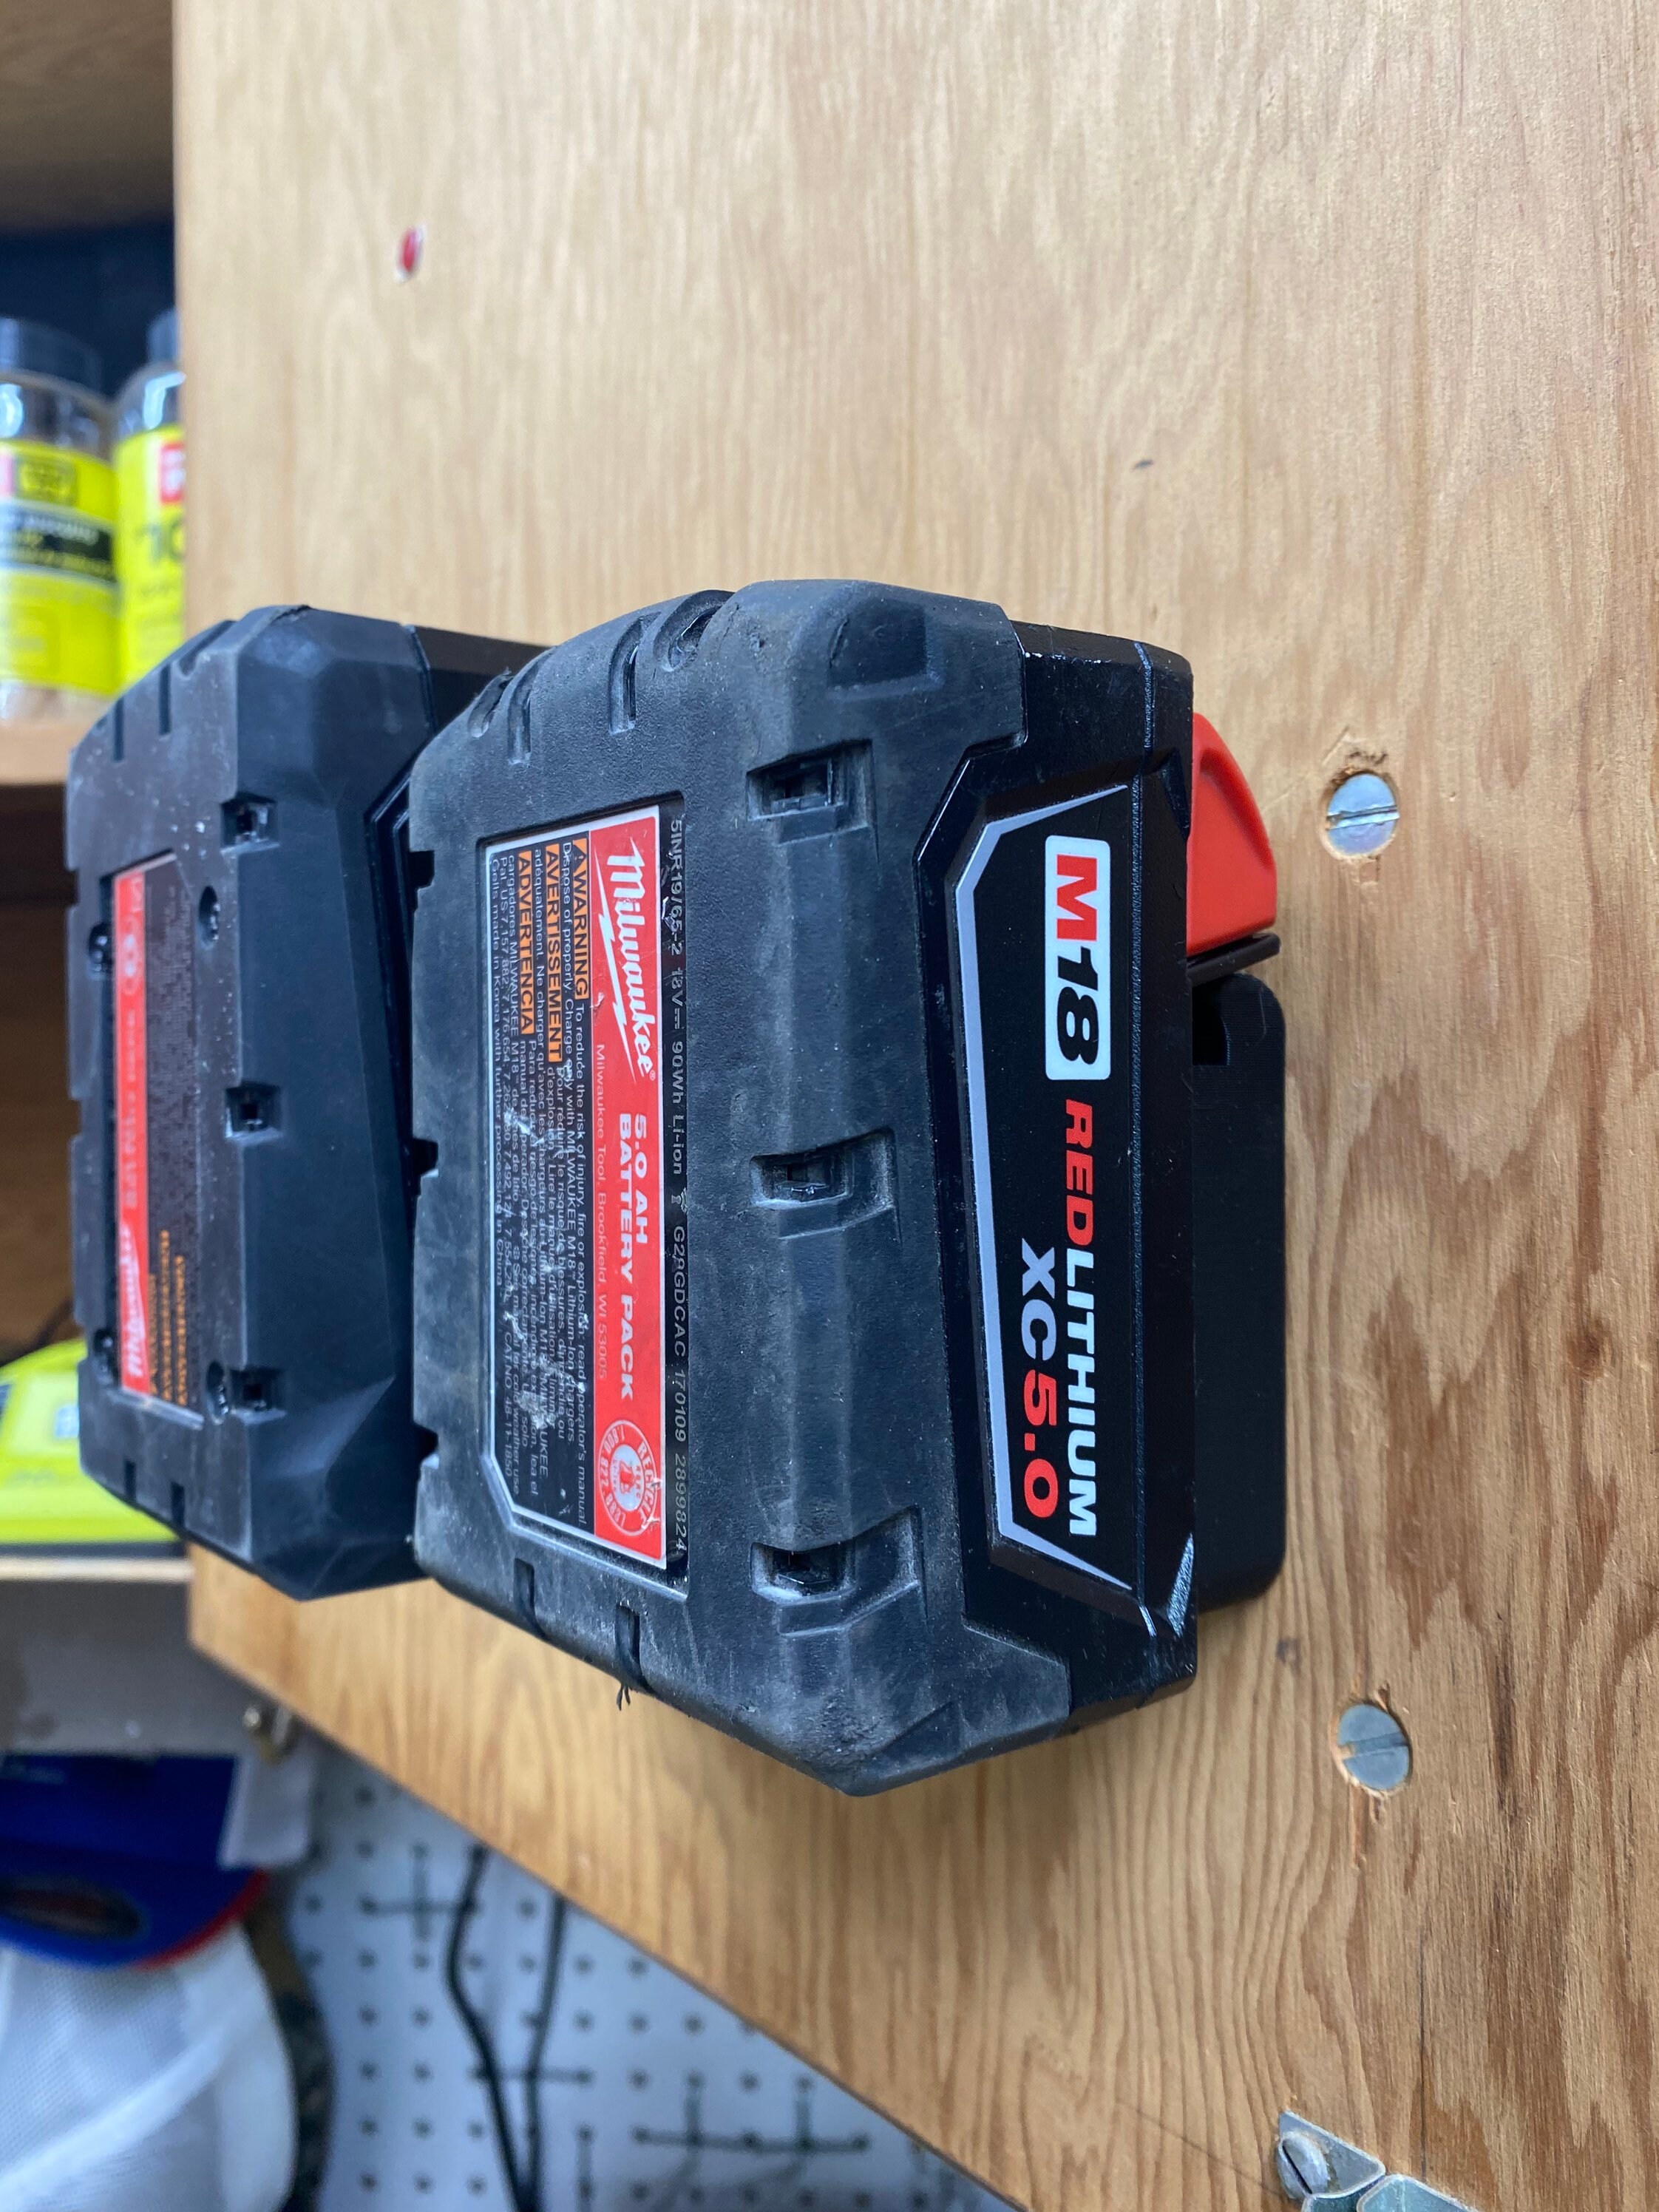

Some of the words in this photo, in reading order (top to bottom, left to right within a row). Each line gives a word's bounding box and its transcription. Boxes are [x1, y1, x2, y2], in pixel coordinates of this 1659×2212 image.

[492, 860, 501, 899] Cells
[562, 842, 571, 904] Dispose
[500, 890, 509, 910] US
[507, 855, 518, 937] cargadores
[564, 909, 573, 924] of
[492, 905, 501, 951] made
[519, 856, 534, 1031] ADVERTENCIA
[574, 870, 588, 996] WARNING
[492, 956, 501, 969] in
[537, 966, 545, 986] Ne
[546, 851, 561, 1059] AVERTISSEMENT
[606, 837, 656, 1077] Milwaukee
[1056, 853, 1099, 1065] M18
[493, 976, 501, 1022] Korea
[509, 942, 520, 1037] MILWAUKEE
[576, 1002, 585, 1022] To
[535, 991, 546, 1048] charger
[564, 999, 574, 1054] Charge
[494, 1028, 502, 1062] with
[520, 1041, 529, 1094] manual
[528, 1040, 537, 1074] Para
[576, 1027, 586, 1079] reduce
[495, 1067, 503, 1120] further
[536, 1052, 547, 1110] qu'avec
[595, 1044, 606, 1139] Milwaukee
[671, 1041, 684, 1104] 90Wh
[512, 1089, 520, 1107] de
[566, 1095, 575, 1125] with
[577, 1085, 586, 1107] the
[538, 1114, 547, 1135] les
[576, 1113, 586, 1139] risk
[634, 1114, 648, 1178] 5.0
[673, 1115, 685, 1174] Li-ion
[493, 1125, 503, 1214] processing
[512, 1155, 520, 1173] de
[557, 1164, 566, 1178] le
[577, 1144, 586, 1160] of
[548, 1164, 557, 1192] Lire
[566, 1130, 576, 1230] MILWAUKEE
[620, 1113, 634, 1284] BATTERY
[496, 1220, 503, 1233] in
[530, 1201, 539, 1220] de
[548, 1198, 557, 1210] le
[555, 1183, 566, 1228] risque
[577, 1213, 587, 1237] fire
[636, 1190, 648, 1244] AH
[496, 1238, 504, 1286] China
[557, 1233, 566, 1252] de
[577, 1242, 586, 1258] or
[512, 1263, 521, 1291] See
[567, 1286, 577, 1370] Lithium-Ion
[598, 1294, 608, 1317] WI
[512, 1351, 521, 1371] for
[577, 1345, 587, 1380] read
[597, 1323, 608, 1380] 53005
[620, 1295, 634, 1401] PACK
[512, 1374, 522, 1402] cold
[674, 1368, 687, 1442] 170109
[504, 1396, 513, 1476] 48-11-1850
[513, 1408, 521, 1465] weather
[521, 1417, 530, 1447] solo
[558, 1420, 565, 1439] ou
[530, 1454, 539, 1476] lea
[637, 1440, 654, 1523] RECYCLE
[531, 1481, 539, 1496] el
[674, 1453, 688, 1552] 2899824
